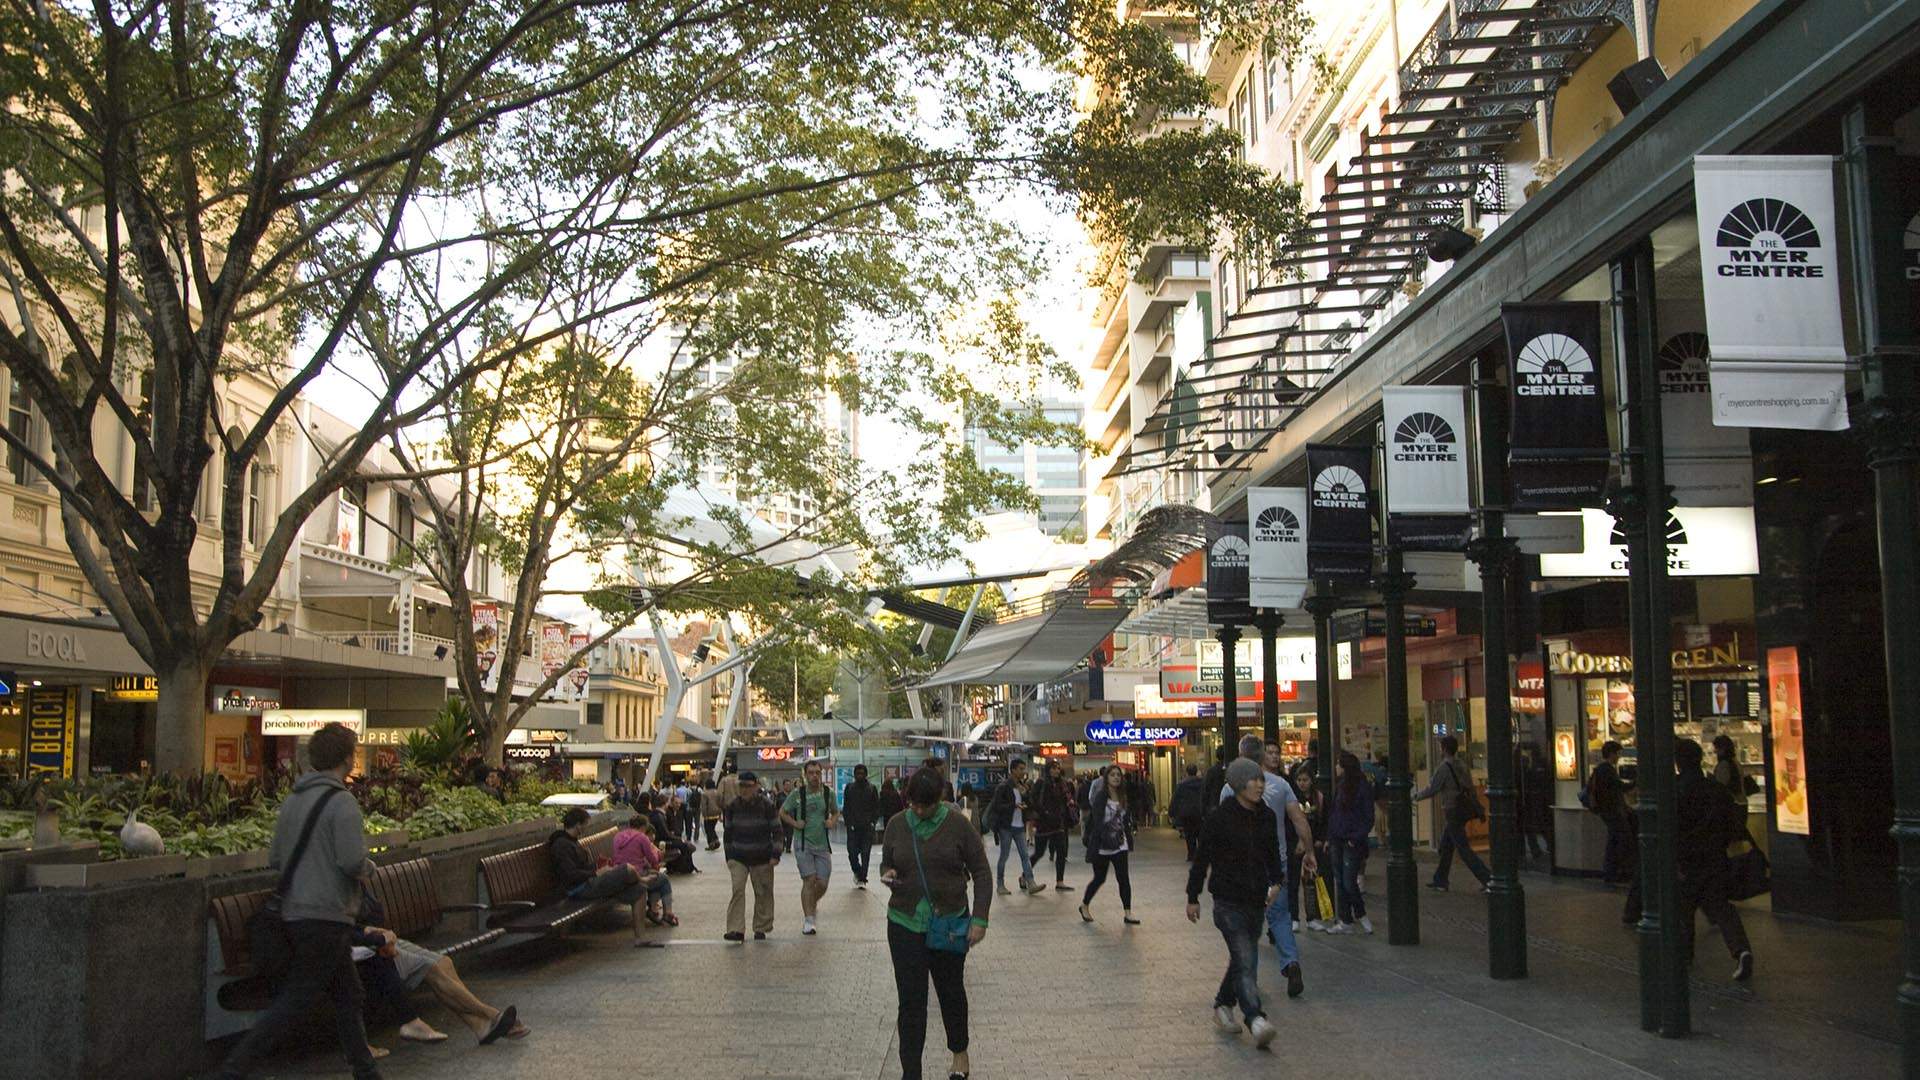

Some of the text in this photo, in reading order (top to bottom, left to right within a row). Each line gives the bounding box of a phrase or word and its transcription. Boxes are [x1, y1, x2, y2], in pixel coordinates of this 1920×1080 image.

[1759, 240, 1778, 248] THE
[1730, 250, 1808, 262] MYER
[1717, 265, 1824, 278] CENTRE
[1526, 374, 1585, 384] MYER
[1666, 372, 1708, 382] MYE
[1517, 385, 1596, 396] CENTRE
[1659, 383, 1711, 393] CENT
[1402, 445, 1449, 453] MYER
[1394, 454, 1457, 462] CENTRE
[1320, 492, 1360, 501] MYER
[1313, 499, 1367, 509] CENTRE
[1560, 641, 1735, 674] COPENGEN
[1168, 681, 1224, 695] Westpa
[264, 719, 359, 729] priceline phaacy
[357, 730, 399, 744] UPRÉ
[1090, 727, 1184, 740] WALLACE BISHOP
